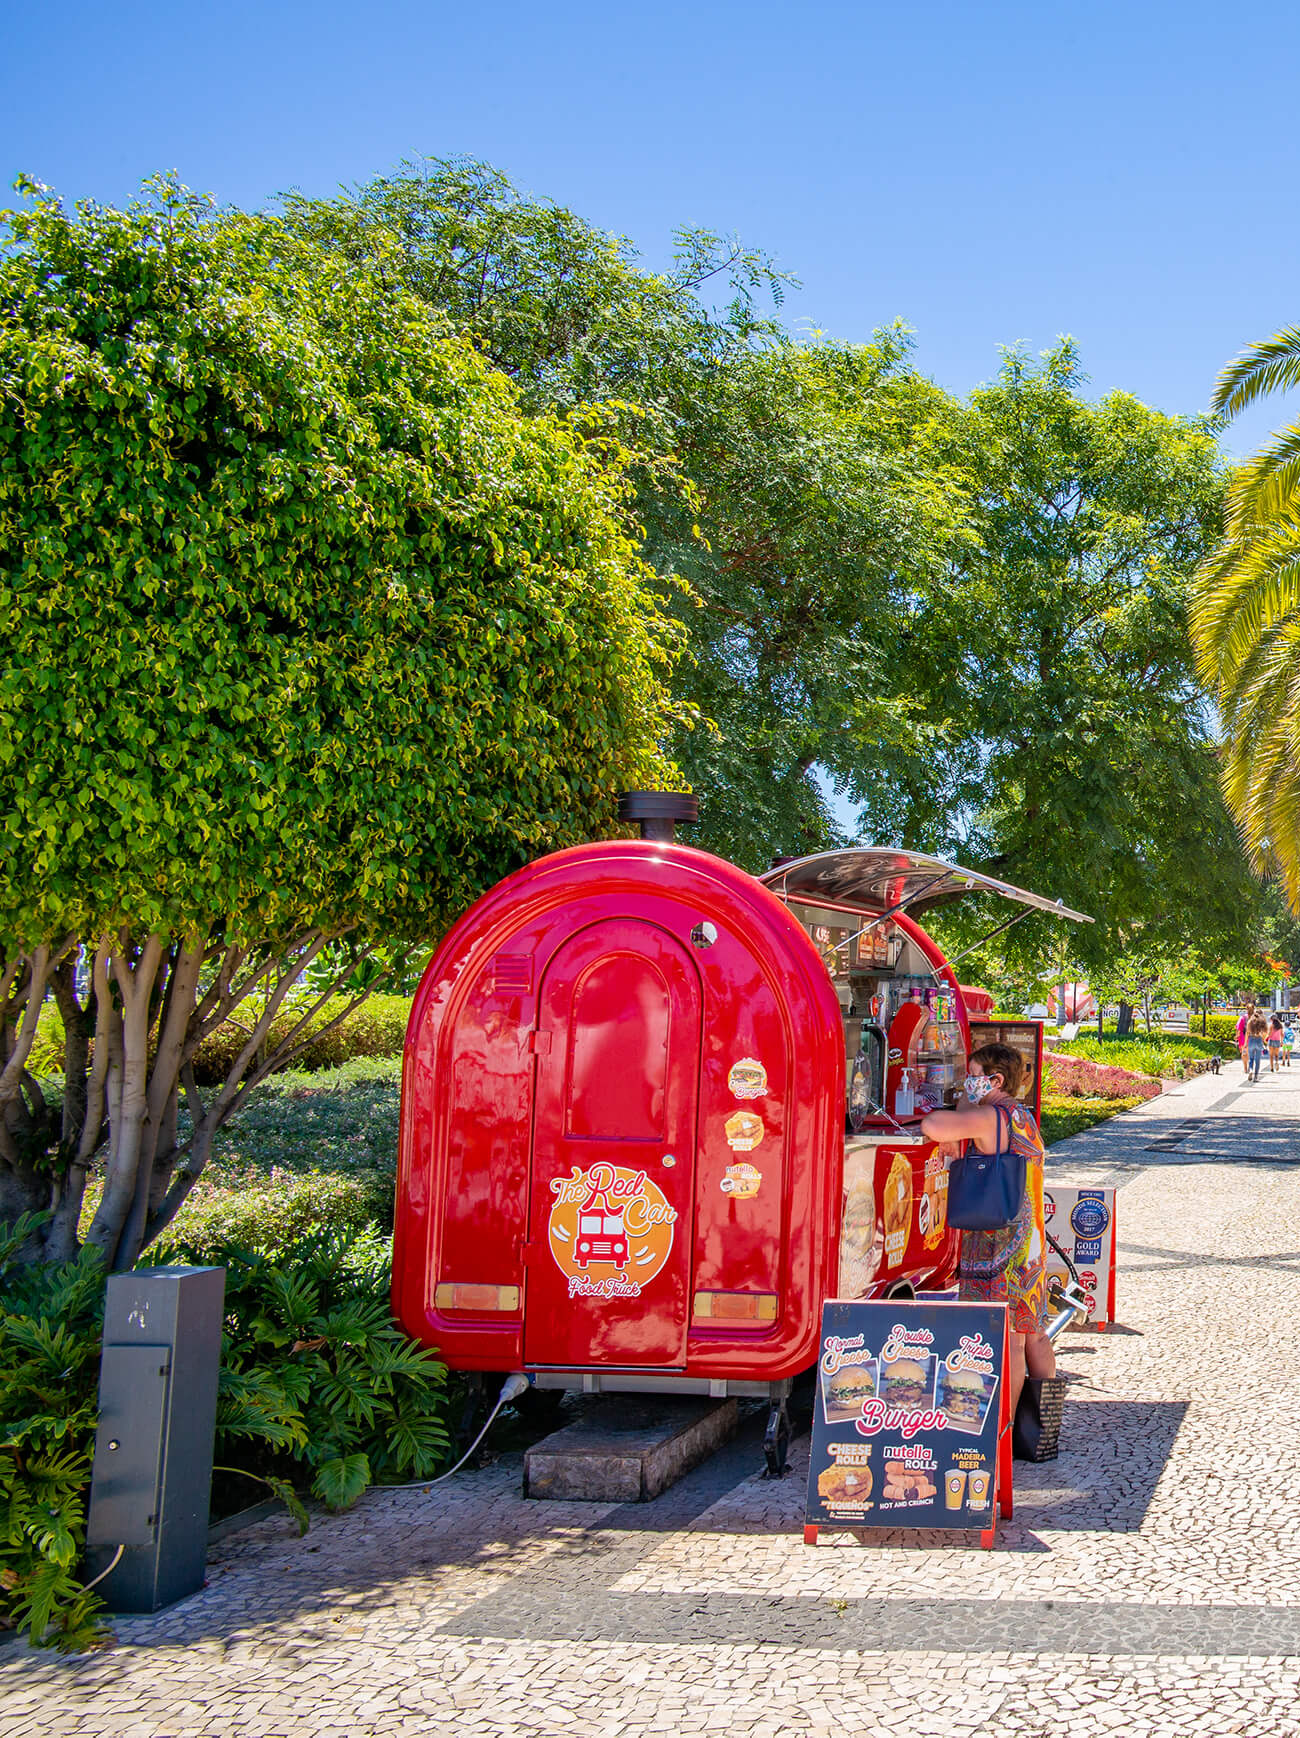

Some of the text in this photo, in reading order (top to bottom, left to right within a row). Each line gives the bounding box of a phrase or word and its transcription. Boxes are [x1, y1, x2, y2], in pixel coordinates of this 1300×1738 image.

[550, 1166, 588, 1209] The
[580, 1161, 648, 1216] Red
[623, 1195, 678, 1237] Car
[1048, 1245, 1073, 1256] Ber
[1076, 1242, 1100, 1250] GOLD
[568, 1272, 641, 1299] Food Truck
[824, 1333, 865, 1353] Normal
[889, 1324, 935, 1344] Double
[882, 1339, 930, 1362] Cheese
[959, 1332, 993, 1359] Triple
[822, 1349, 871, 1376] Cheese
[946, 1349, 993, 1374] Cheese
[855, 1397, 949, 1440] Burger
[827, 1443, 872, 1457] CHEESE
[836, 1455, 867, 1465] ROLLS
[883, 1444, 933, 1461] nutella
[952, 1453, 986, 1461] MADEIRA
[904, 1459, 938, 1470] ROLLS
[958, 1460, 979, 1469] BEER
[879, 1502, 893, 1510] HOT
[894, 1501, 907, 1509] AND
